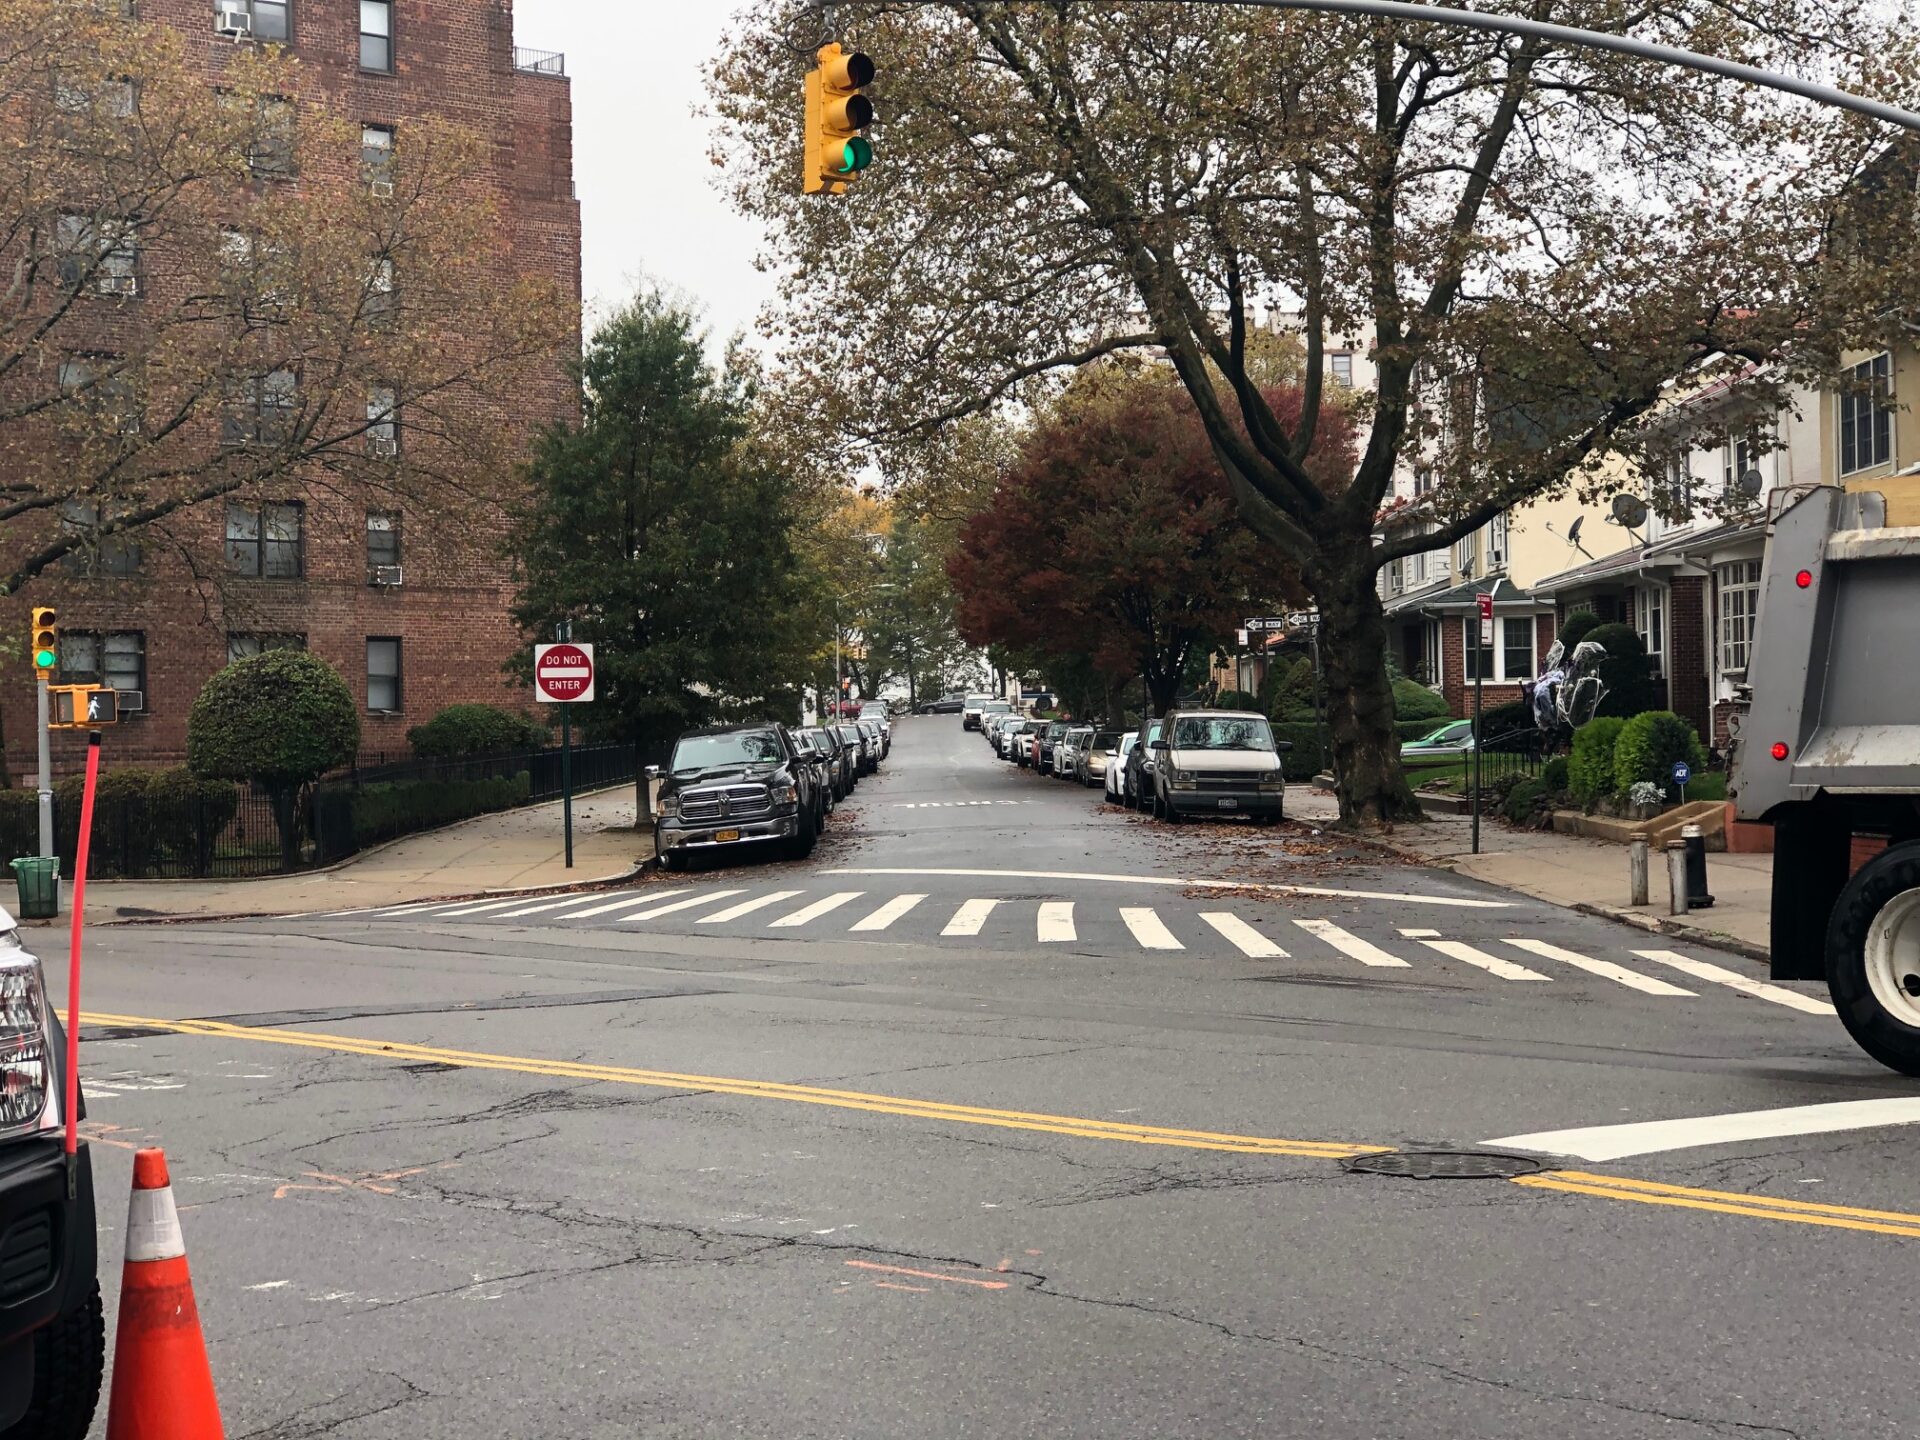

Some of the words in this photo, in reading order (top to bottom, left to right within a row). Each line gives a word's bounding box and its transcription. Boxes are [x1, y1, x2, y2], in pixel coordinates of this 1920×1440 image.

[546, 655, 560, 665] DO
[563, 655, 582, 665] NOT
[549, 680, 580, 690] ENTER
[1675, 769, 1687, 777] ADT
